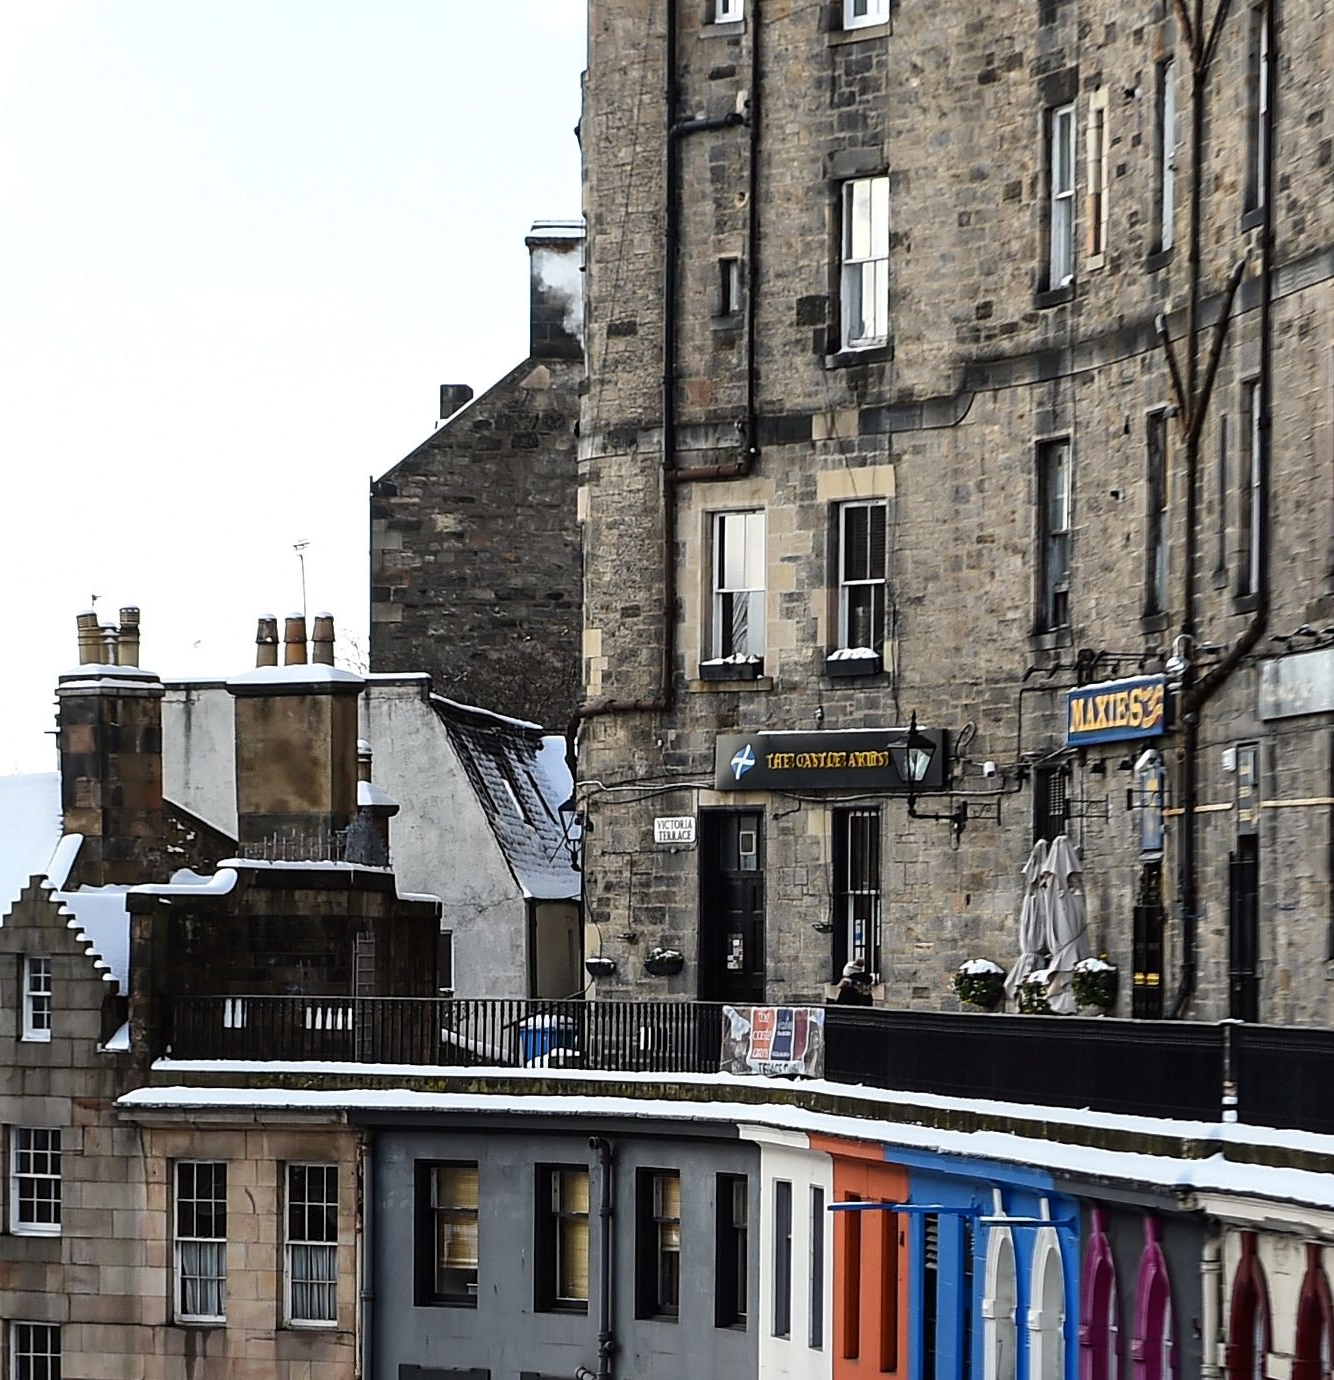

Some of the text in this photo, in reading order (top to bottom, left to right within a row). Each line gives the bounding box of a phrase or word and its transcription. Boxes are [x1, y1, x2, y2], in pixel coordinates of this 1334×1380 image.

[1069, 686, 1145, 733] MAXIES
[766, 751, 889, 770] THE CASTLE ARMS
[657, 819, 693, 830] VICTORIA
[658, 830, 692, 841] TERRACE
